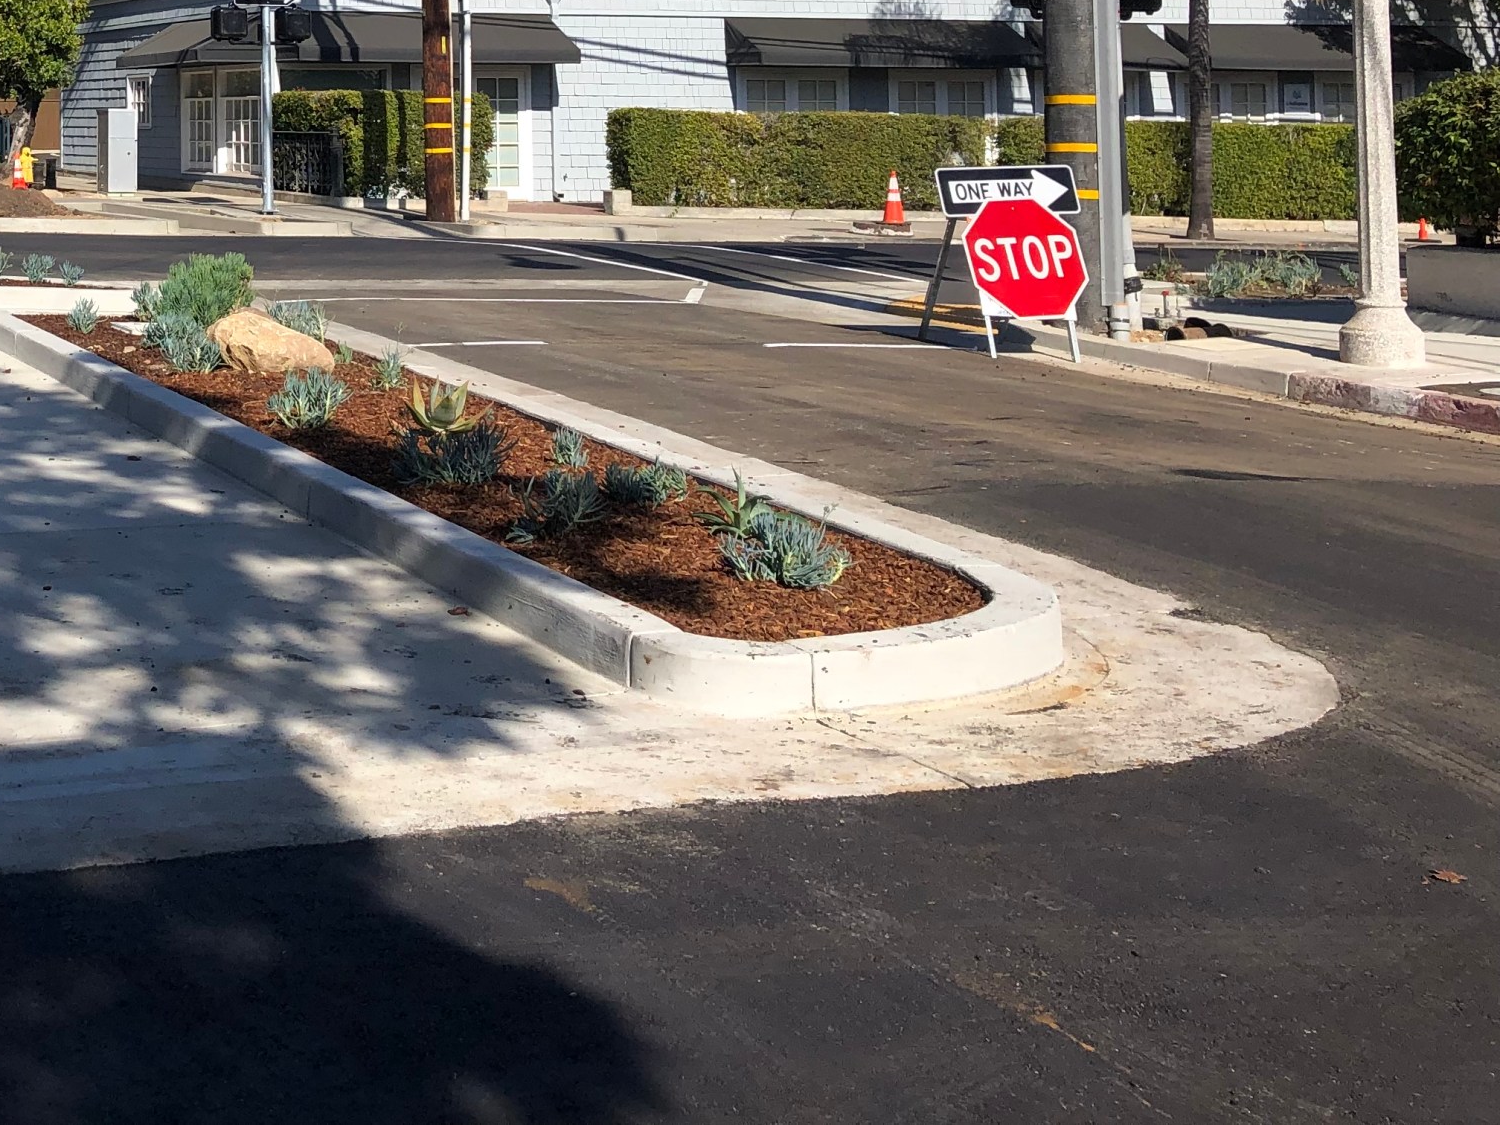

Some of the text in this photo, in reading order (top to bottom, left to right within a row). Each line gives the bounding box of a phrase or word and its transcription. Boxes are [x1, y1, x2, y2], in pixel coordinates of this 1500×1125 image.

[955, 181, 1033, 200] ONE WAY
[974, 234, 1073, 283] STOP
